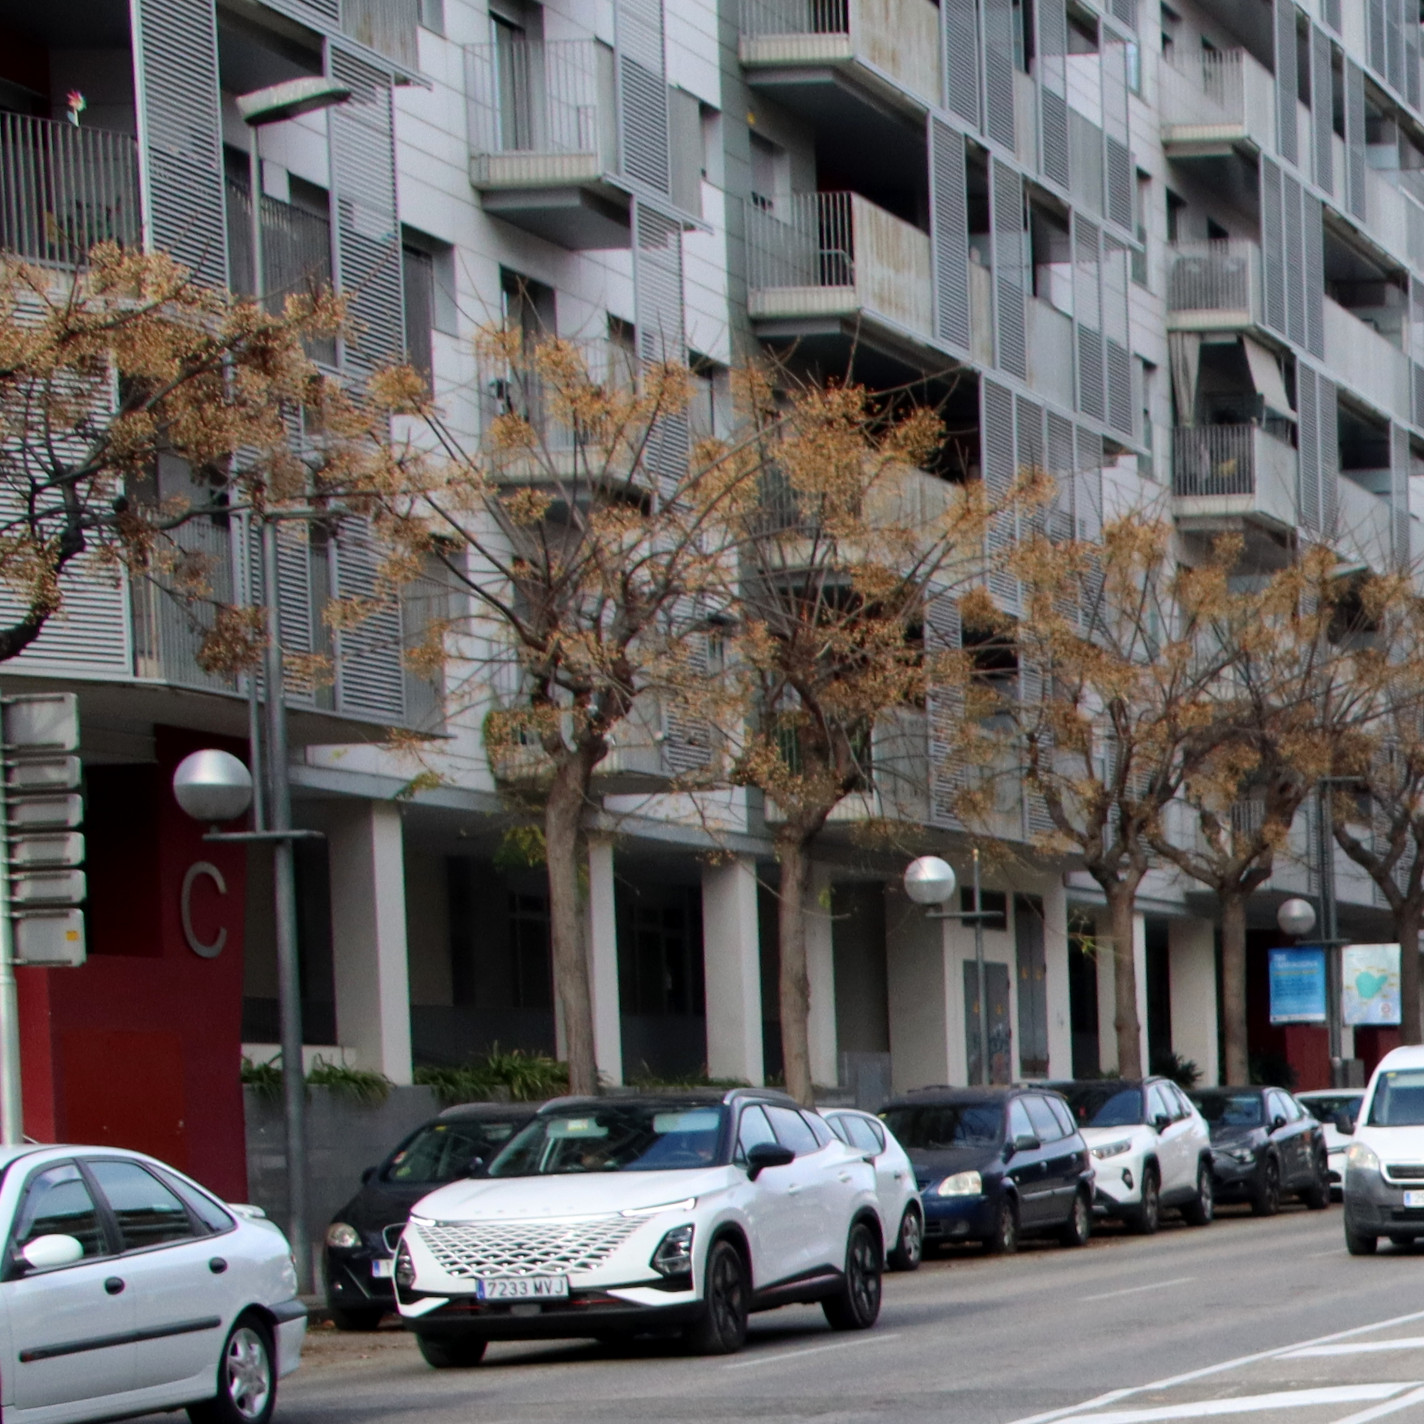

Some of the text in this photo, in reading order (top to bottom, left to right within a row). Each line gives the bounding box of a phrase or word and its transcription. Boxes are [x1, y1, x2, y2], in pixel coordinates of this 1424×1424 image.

[181, 861, 227, 959] C
[487, 1279, 564, 1297] 7233 MVJ
